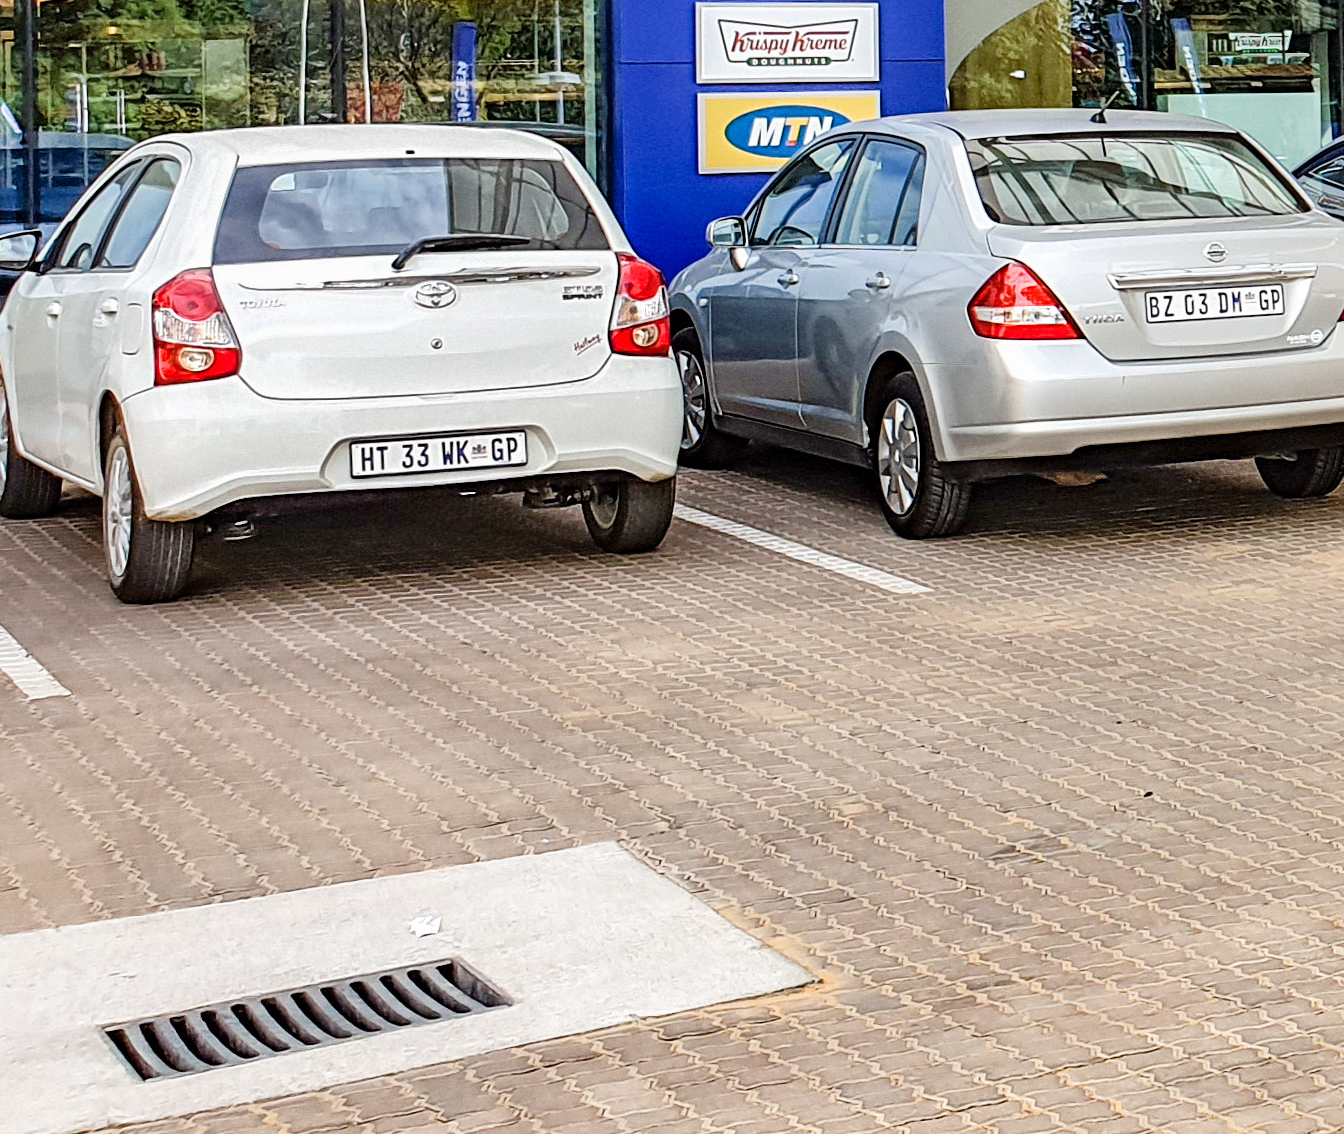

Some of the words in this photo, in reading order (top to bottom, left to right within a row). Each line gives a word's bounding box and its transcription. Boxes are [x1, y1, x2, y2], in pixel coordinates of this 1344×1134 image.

[730, 30, 792, 56] Krispy
[791, 30, 850, 53] Kreme
[751, 57, 827, 66] DOUGHNUTS
[747, 116, 834, 147] MTN
[1150, 295, 1175, 318] BZ
[1218, 290, 1242, 314] DM
[1258, 288, 1281, 311] GP
[360, 446, 388, 472] HT
[401, 443, 430, 468] 33
[441, 439, 470, 466] WK
[491, 437, 519, 463] GP
